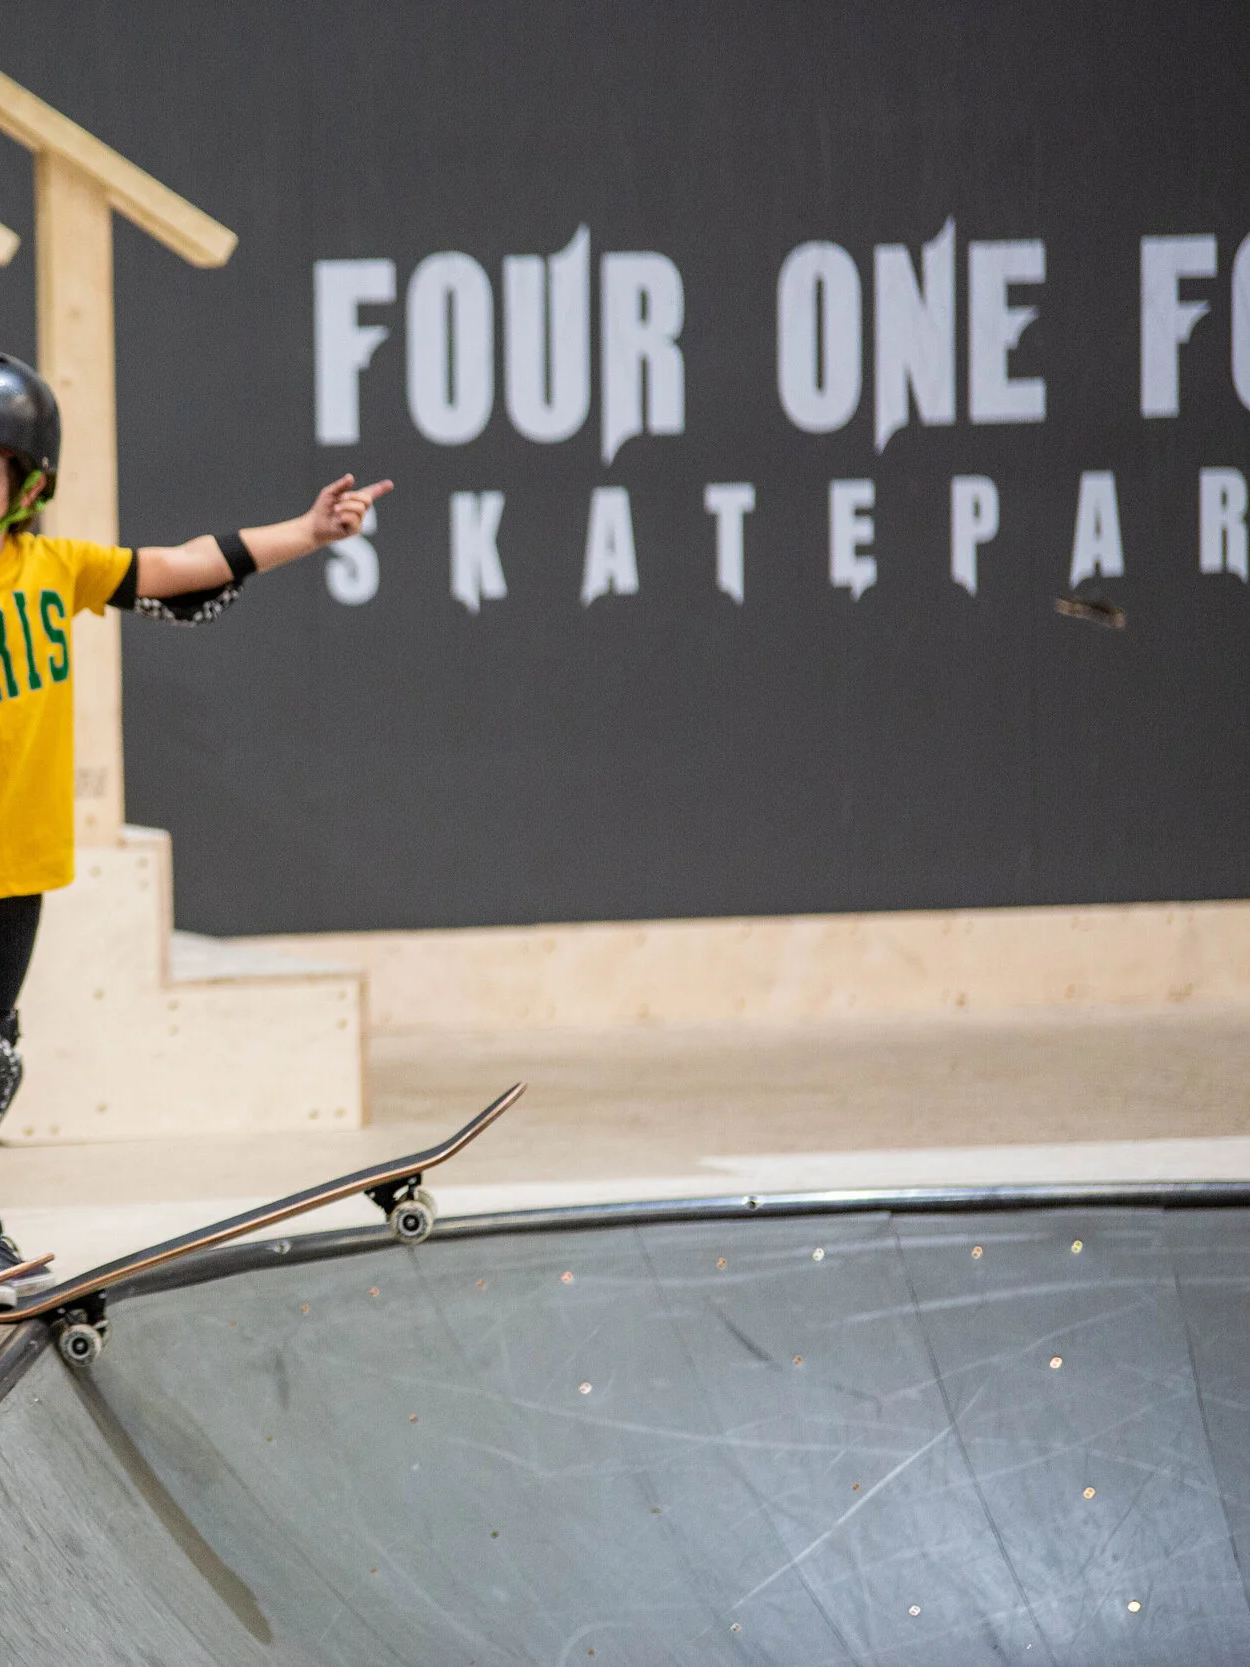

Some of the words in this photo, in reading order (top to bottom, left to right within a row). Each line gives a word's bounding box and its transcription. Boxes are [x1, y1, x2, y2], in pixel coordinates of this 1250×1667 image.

[313, 223, 686, 465] FOUR
[776, 215, 1047, 453] ONE
[1139, 232, 1250, 418] F
